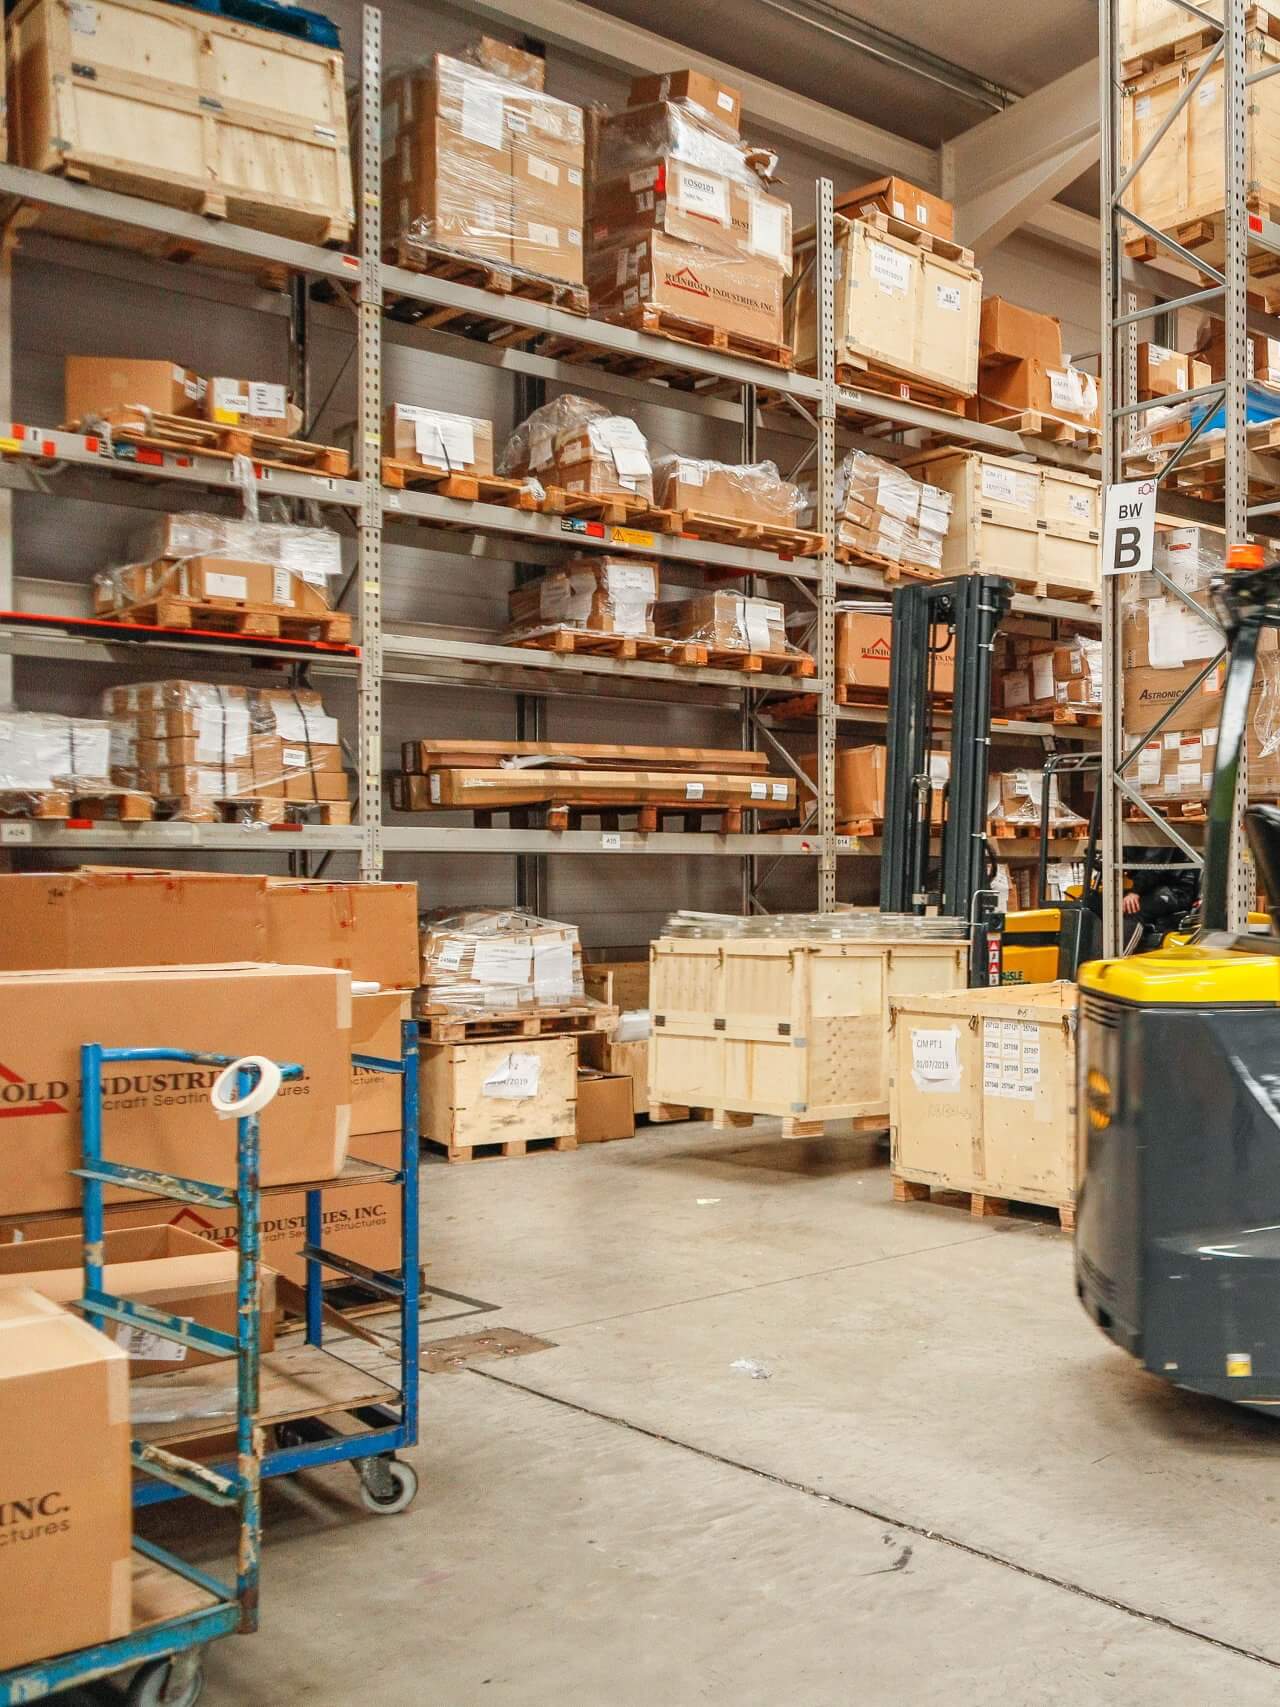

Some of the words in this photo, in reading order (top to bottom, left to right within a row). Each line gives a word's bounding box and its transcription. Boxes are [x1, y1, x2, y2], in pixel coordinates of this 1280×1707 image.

[1138, 483, 1155, 495] EOS
[1119, 502, 1143, 519] BW
[1114, 526, 1141, 569] B
[1140, 689, 1184, 700] ASTRONIC
[154, 1091, 208, 1107] Seatin
[355, 1204, 387, 1219] INC.
